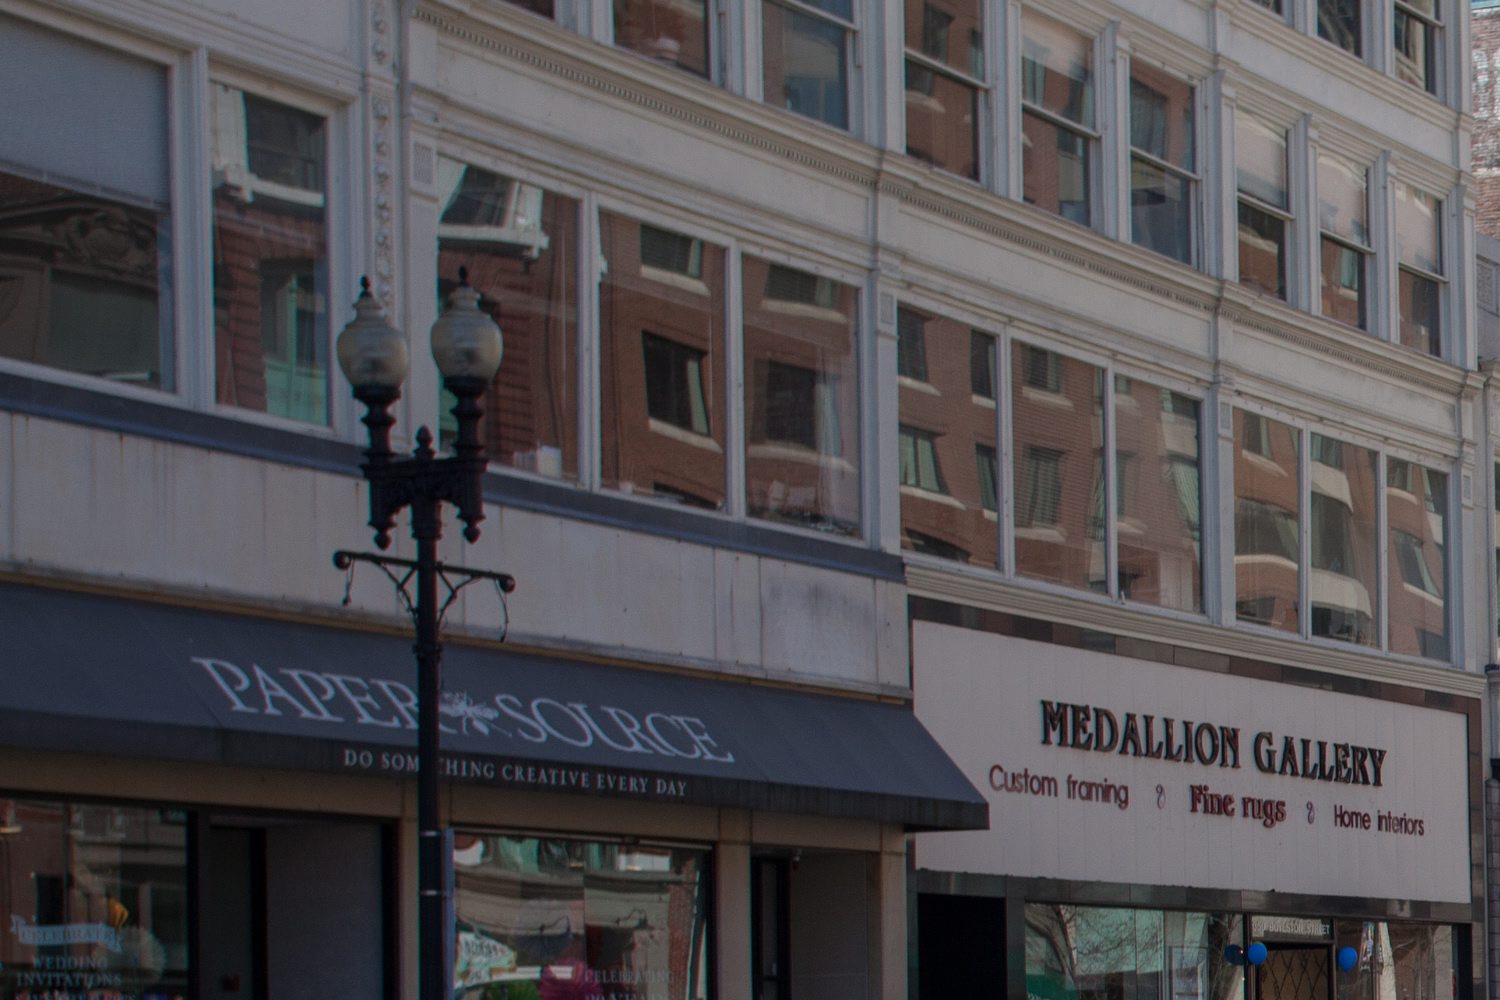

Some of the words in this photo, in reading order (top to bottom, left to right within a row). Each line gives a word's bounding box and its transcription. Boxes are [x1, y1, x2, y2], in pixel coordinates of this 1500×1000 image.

[191, 656, 457, 735] PAPER
[495, 693, 735, 763] SOURCE
[344, 748, 374, 769] DO
[381, 751, 494, 780] SOMHING
[502, 763, 590, 789] CREATIVE
[597, 772, 649, 794] EVERY
[656, 778, 688, 797] DAY
[1040, 699, 1241, 769] MEDALLION
[1254, 731, 1388, 787] GALLERY
[989, 764, 1057, 797] Custom
[1067, 773, 1129, 810] framing
[1190, 784, 1235, 817] Fine
[1243, 795, 1287, 828] rugs
[1334, 804, 1371, 831] Home
[1378, 809, 1425, 837] interiors
[17, 972, 122, 987] INVITATIONS
[33, 955, 109, 970] WEDDING
